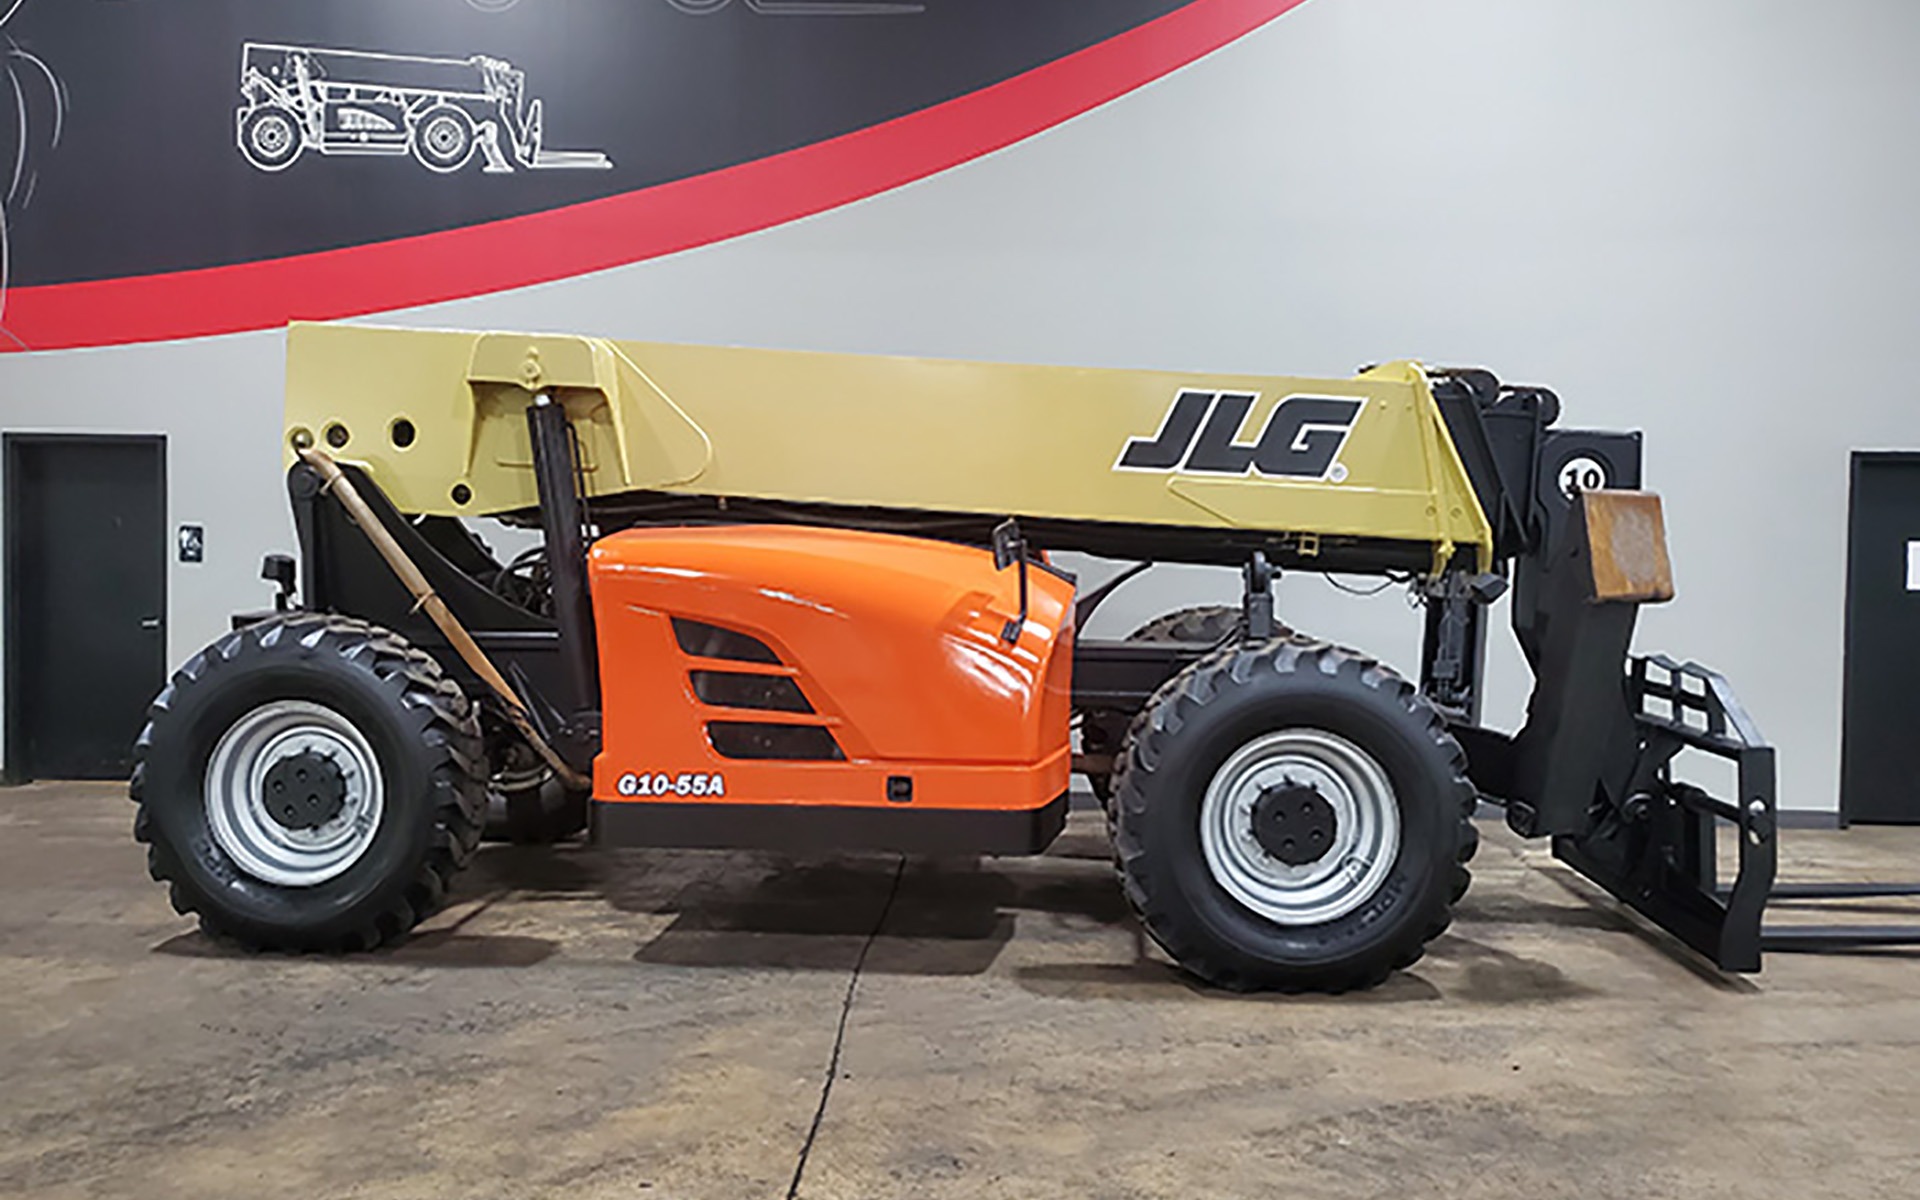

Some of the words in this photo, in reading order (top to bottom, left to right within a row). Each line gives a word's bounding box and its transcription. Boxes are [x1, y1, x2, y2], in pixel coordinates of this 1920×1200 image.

[1113, 388, 1368, 481] JLG
[1565, 467, 1601, 490] 10
[617, 773, 724, 796] G10-55A
